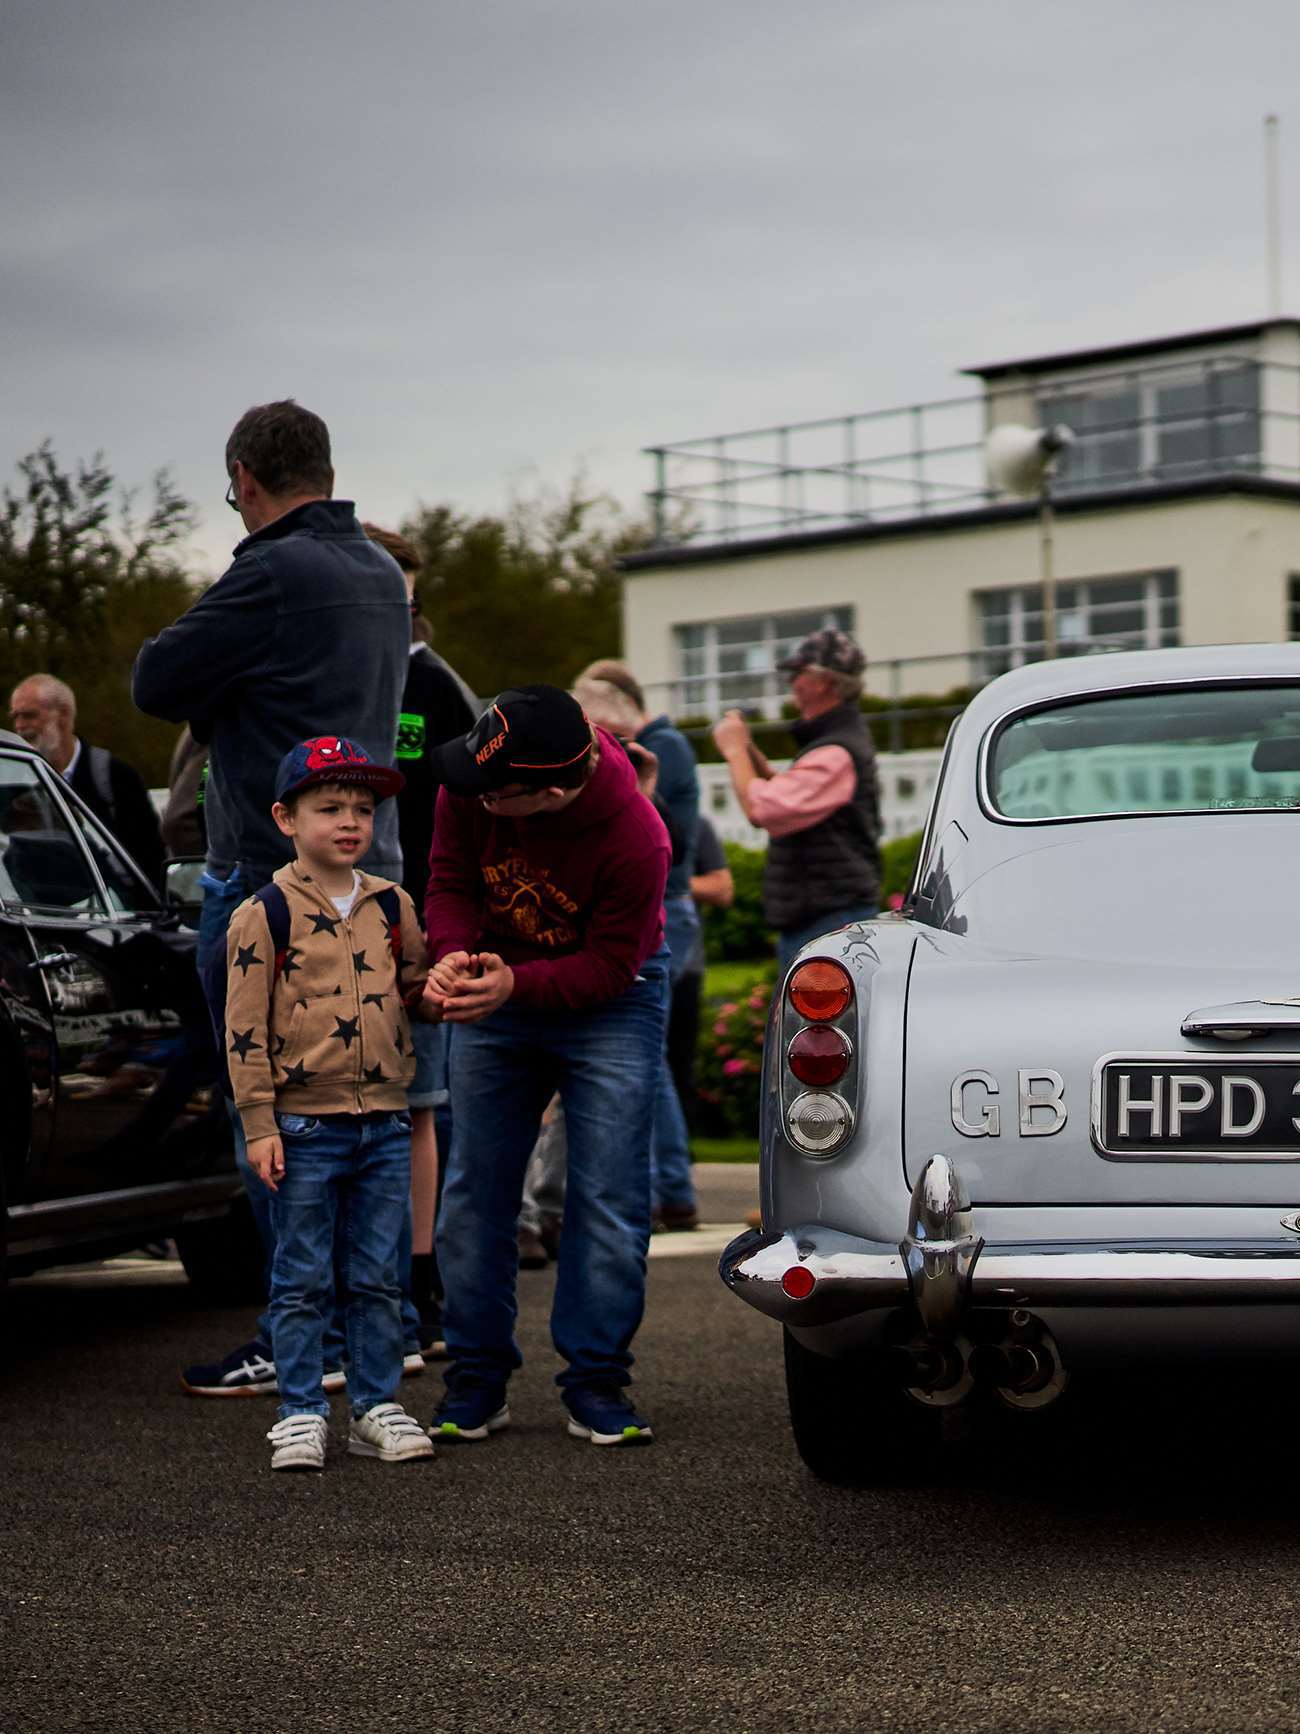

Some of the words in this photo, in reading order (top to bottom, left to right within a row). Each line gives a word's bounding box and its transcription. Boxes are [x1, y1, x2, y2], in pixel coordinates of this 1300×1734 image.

[475, 733, 506, 767] NERF
[949, 1068, 1068, 1138] GB
[1118, 1075, 1267, 1138] HPD
